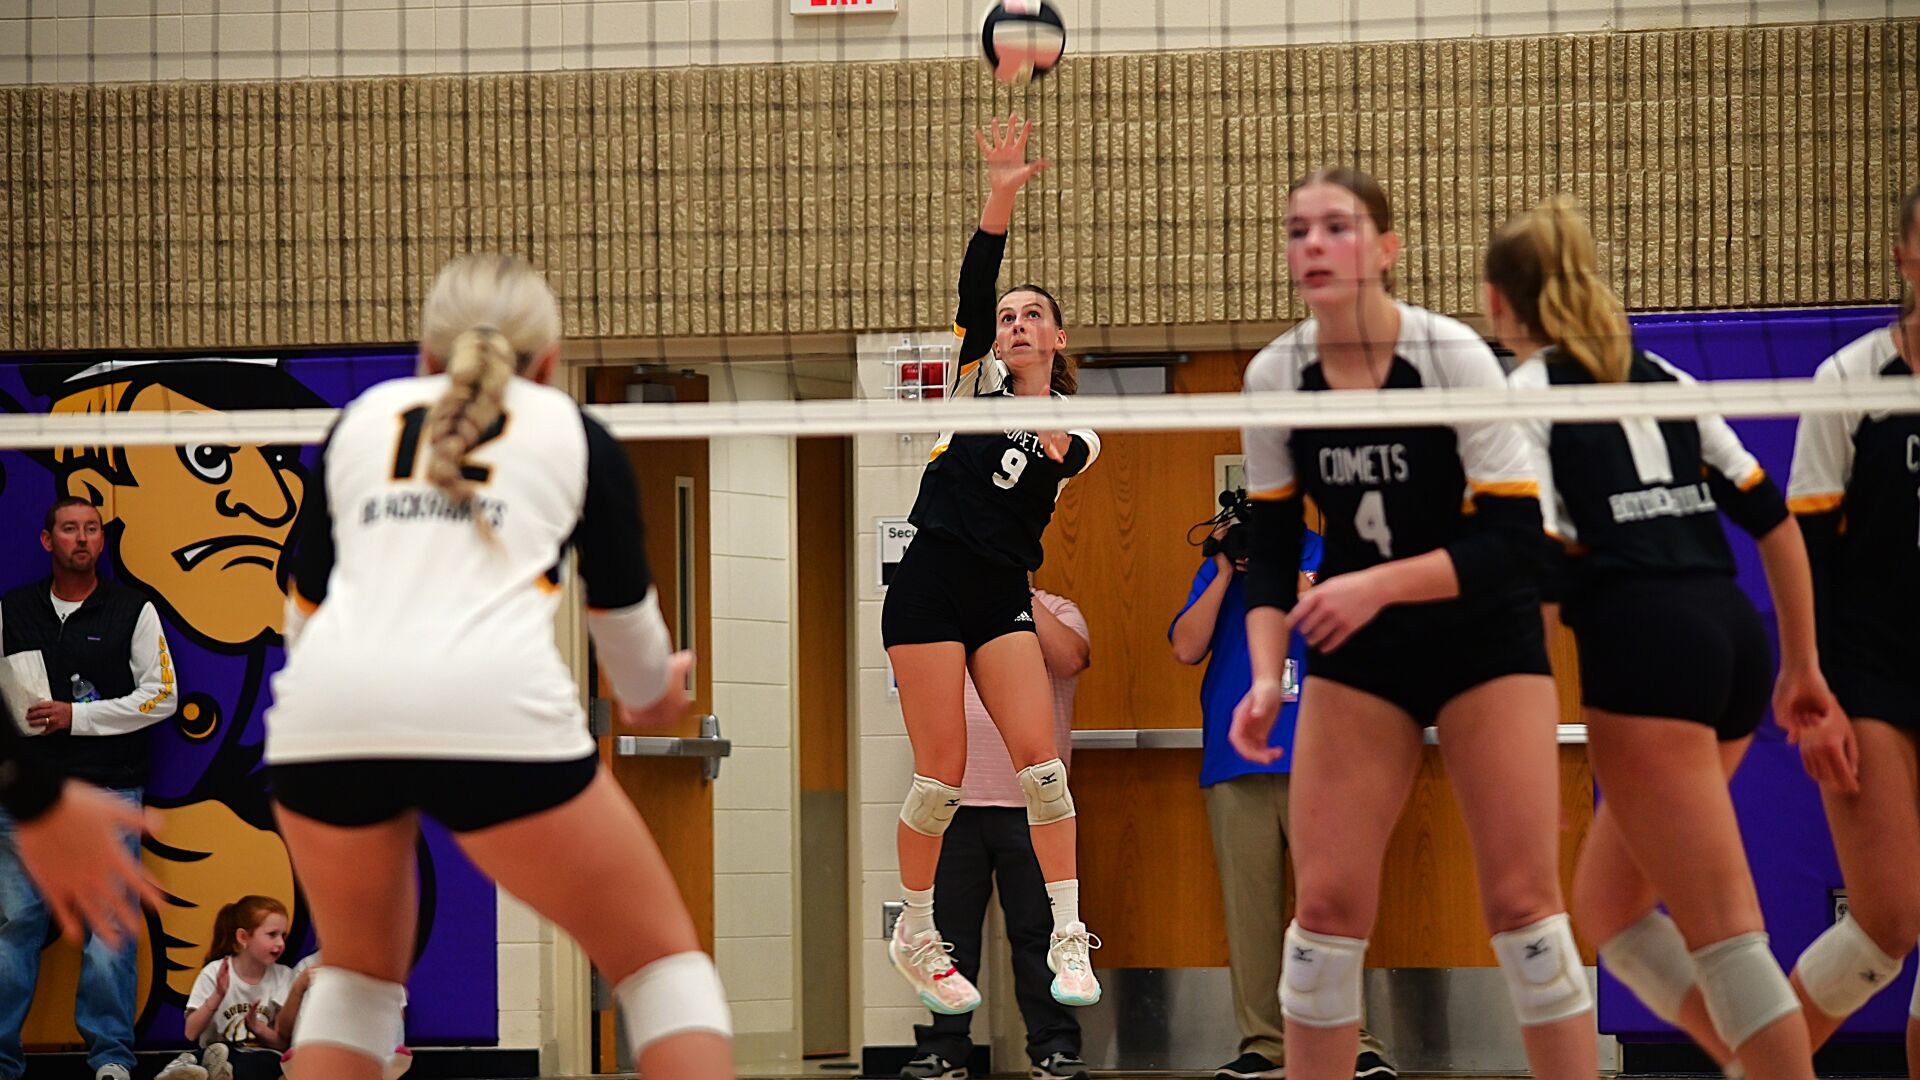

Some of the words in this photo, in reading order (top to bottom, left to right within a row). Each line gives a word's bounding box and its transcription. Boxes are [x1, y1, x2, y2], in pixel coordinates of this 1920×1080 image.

[991, 447, 1028, 490] 9
[1318, 443, 1409, 485] COMETS
[1353, 489, 1393, 559] 4
